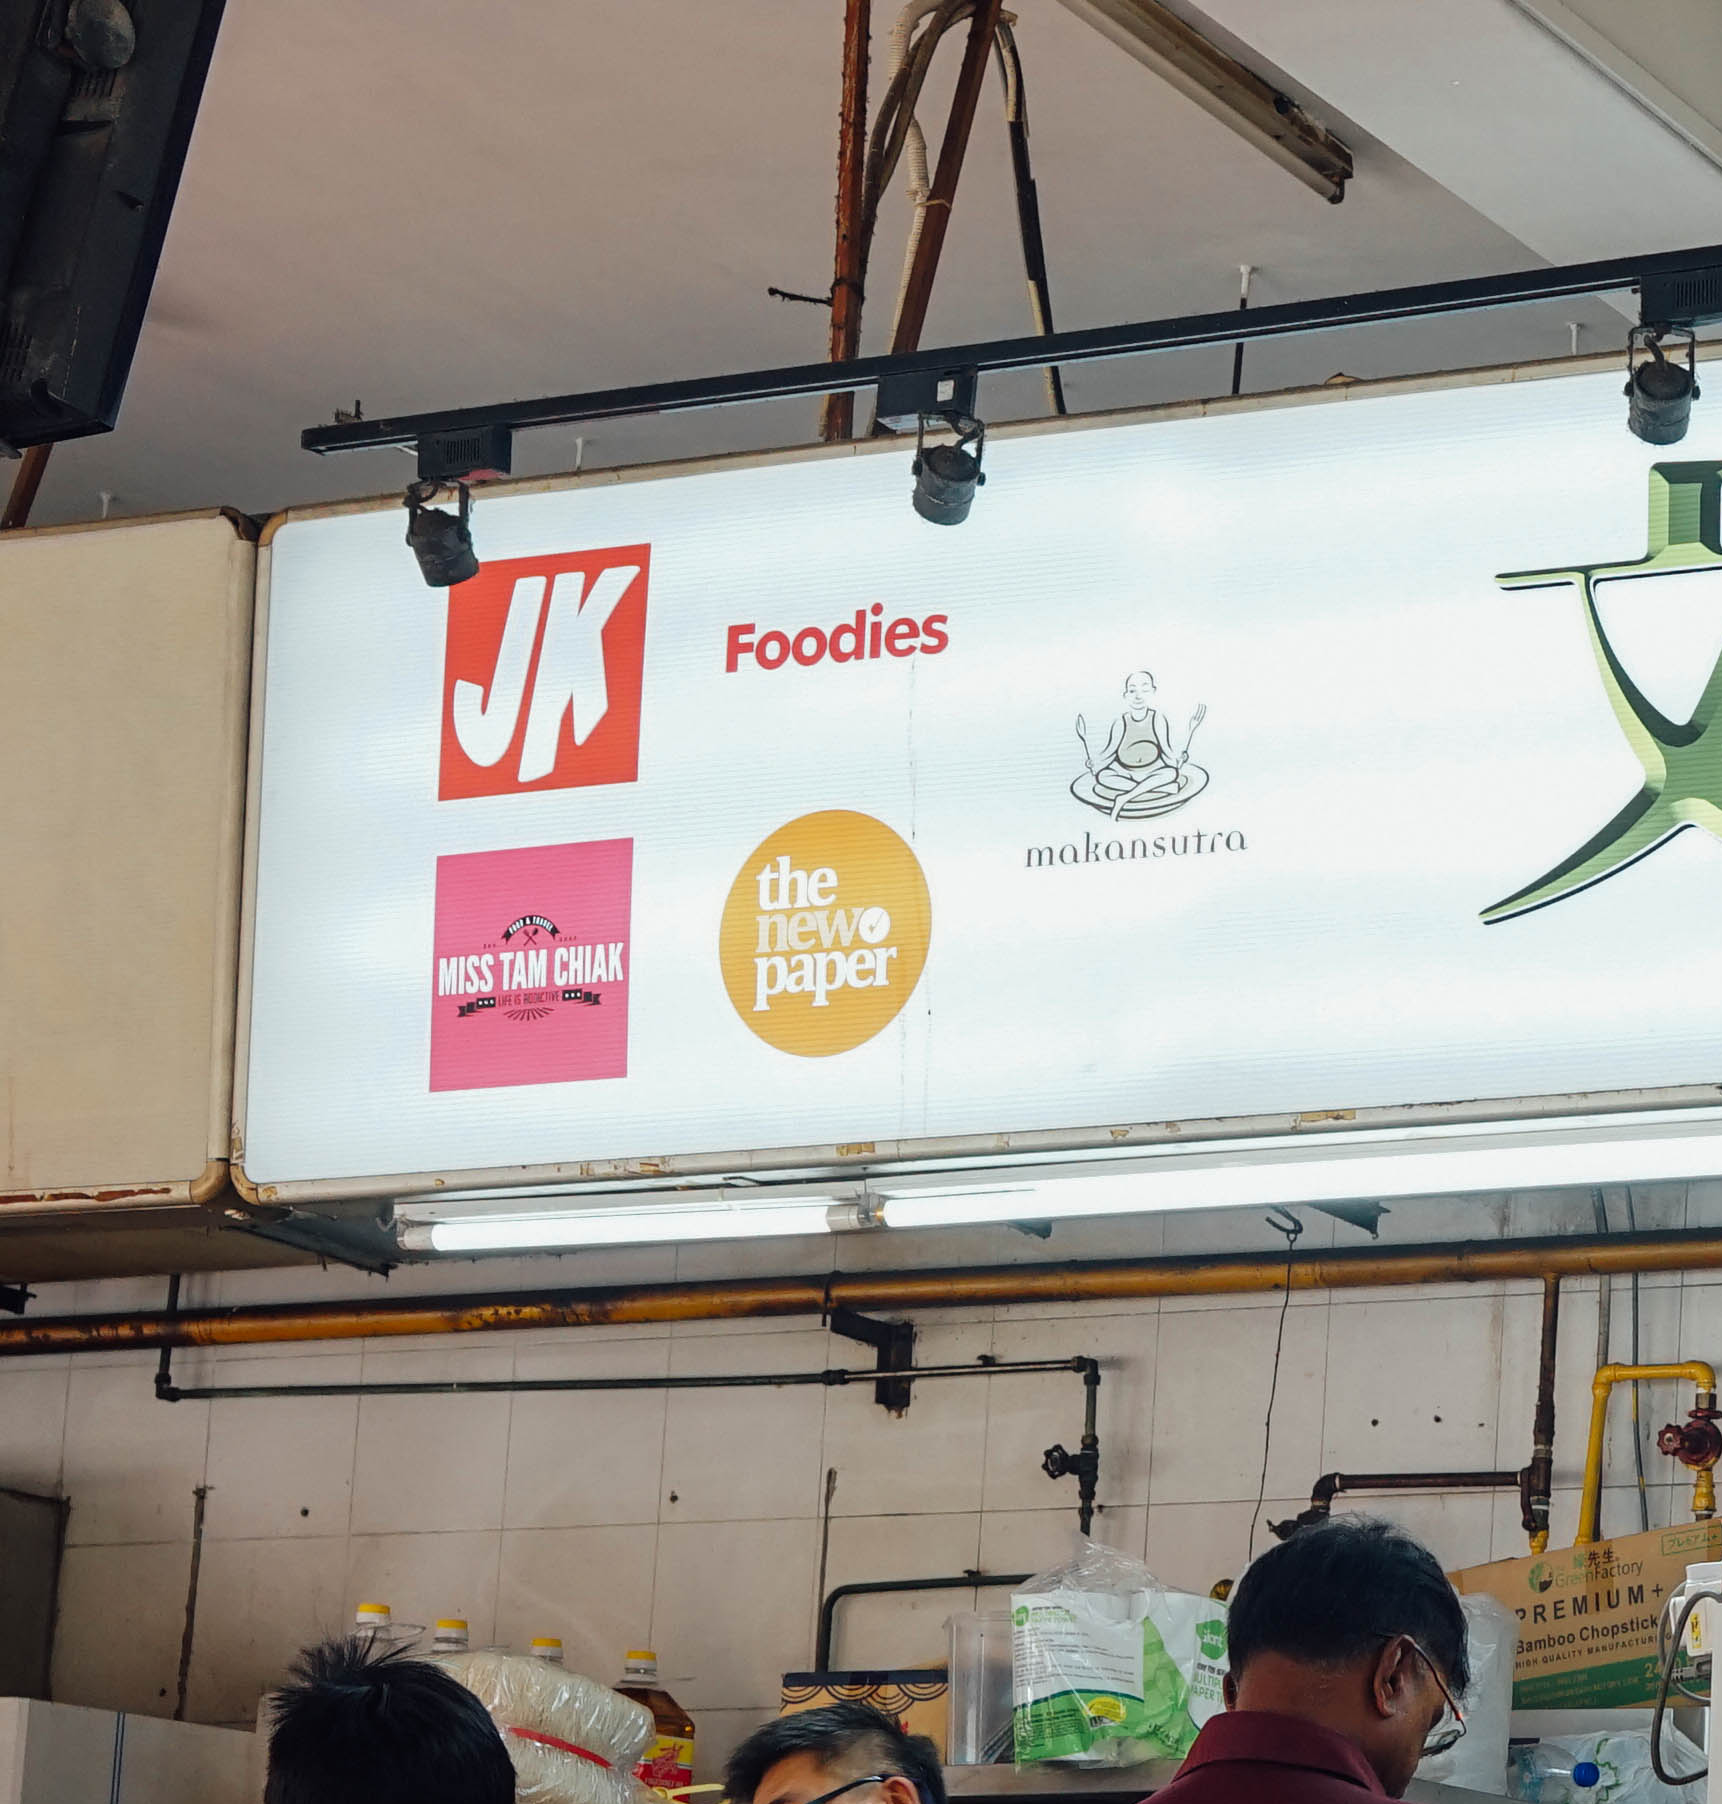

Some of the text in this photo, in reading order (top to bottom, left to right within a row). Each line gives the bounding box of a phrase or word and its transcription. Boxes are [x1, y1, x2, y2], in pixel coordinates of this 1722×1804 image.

[726, 603, 950, 673] Foodies
[453, 566, 641, 783] JK
[1025, 827, 1249, 870] makansutra
[756, 855, 838, 911] the
[438, 942, 624, 996] MISS TAM CHIAK
[752, 941, 898, 1014] paper
[1542, 1647, 1583, 1664] QUALITY
